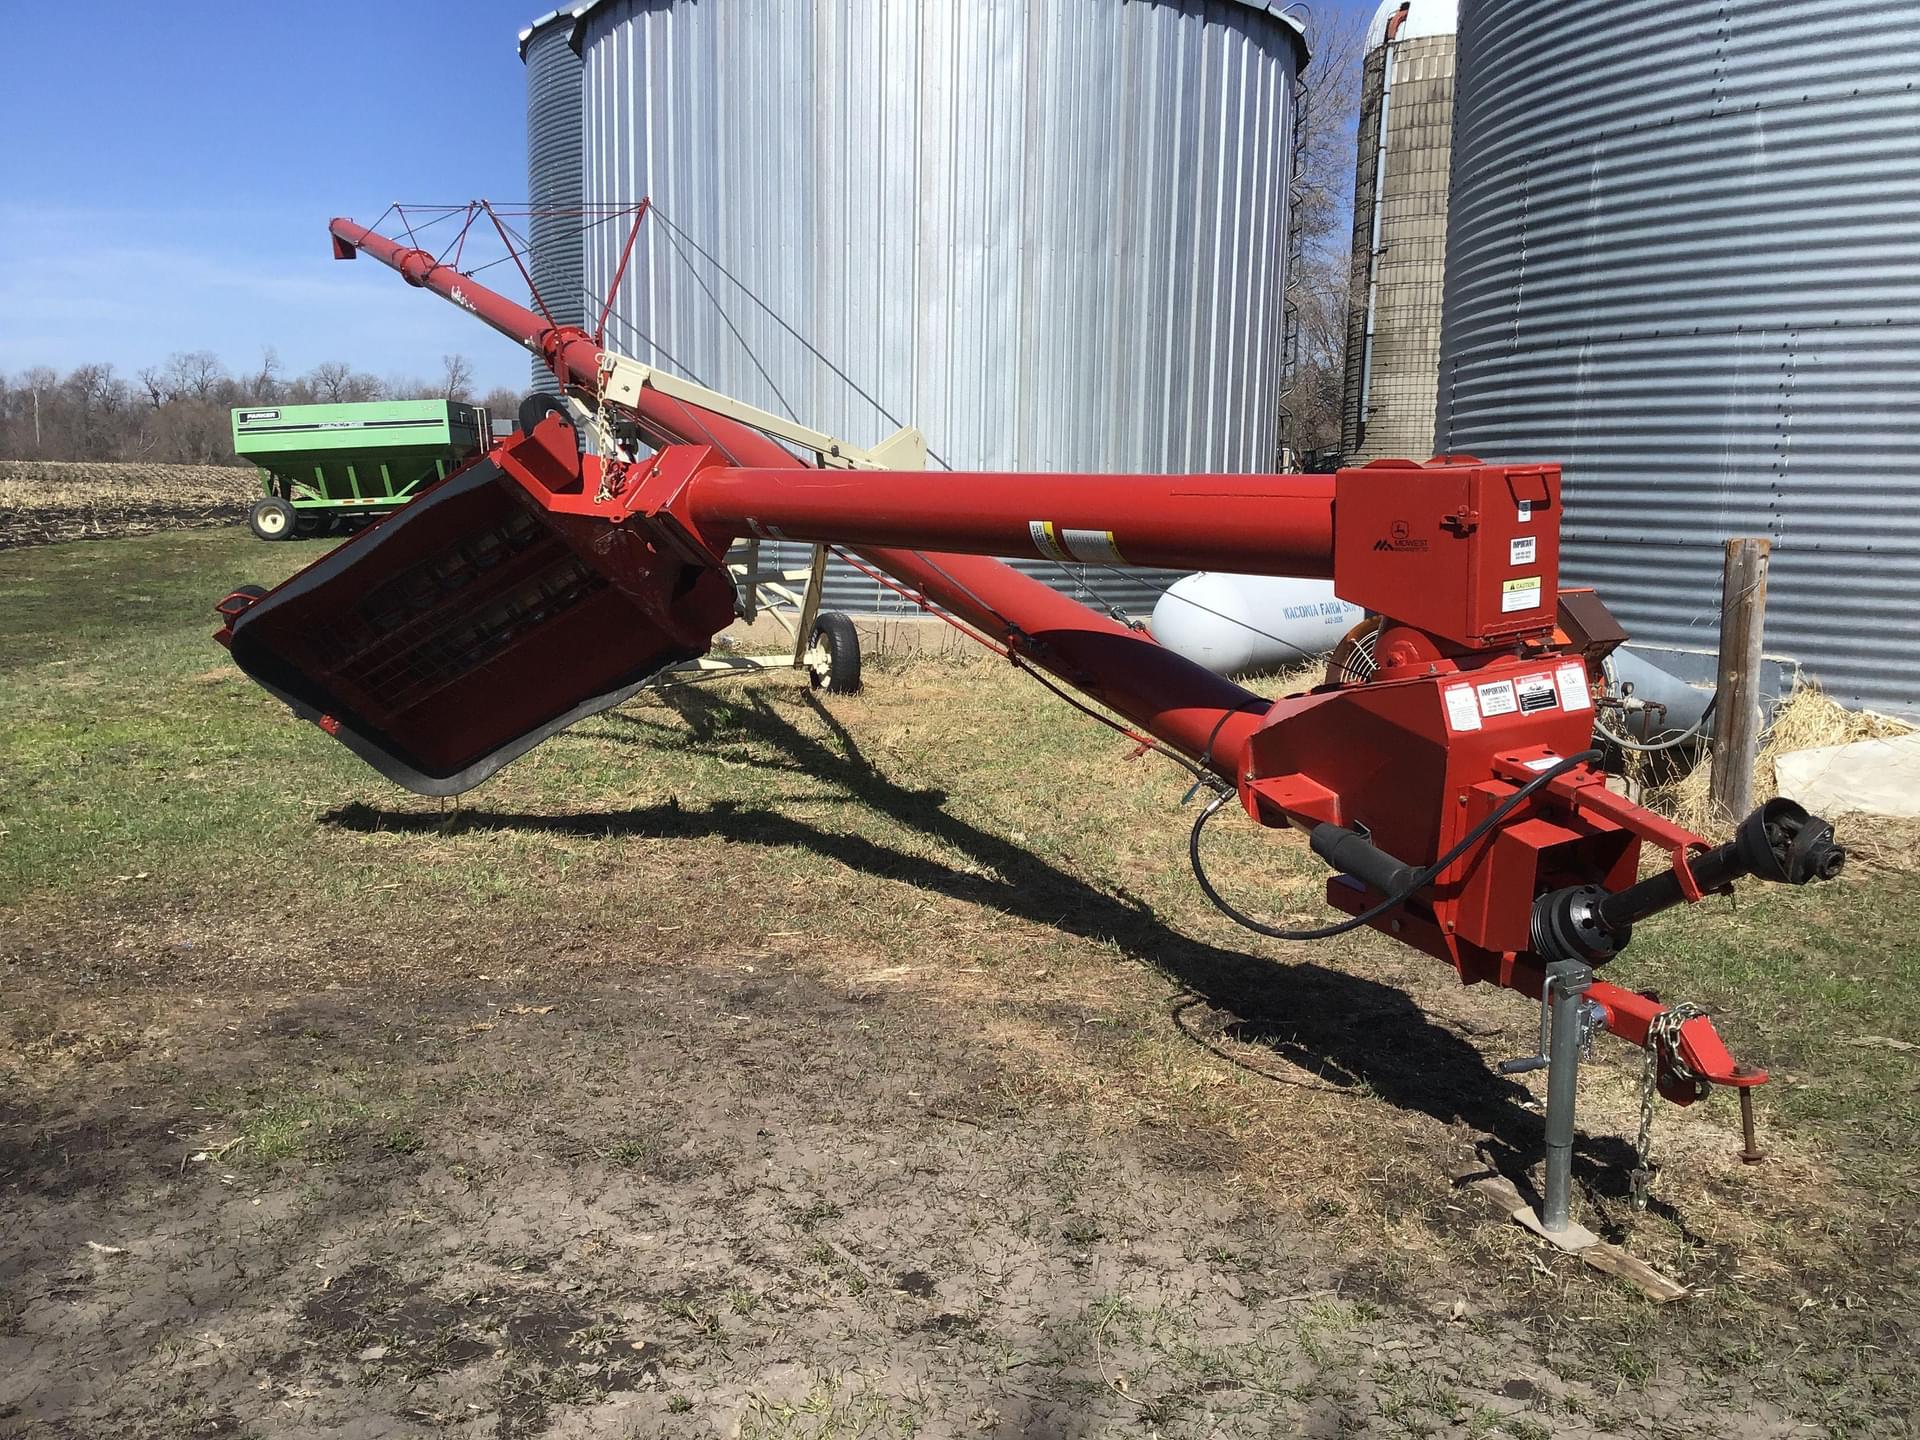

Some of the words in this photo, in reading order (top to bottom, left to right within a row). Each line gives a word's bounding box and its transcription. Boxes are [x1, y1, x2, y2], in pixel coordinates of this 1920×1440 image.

[1515, 581, 1536, 590] CAUTION
[1283, 605, 1319, 619] WACONIA
[1320, 602, 1342, 615] FARM
[1480, 684, 1510, 696] IMPORTANT
